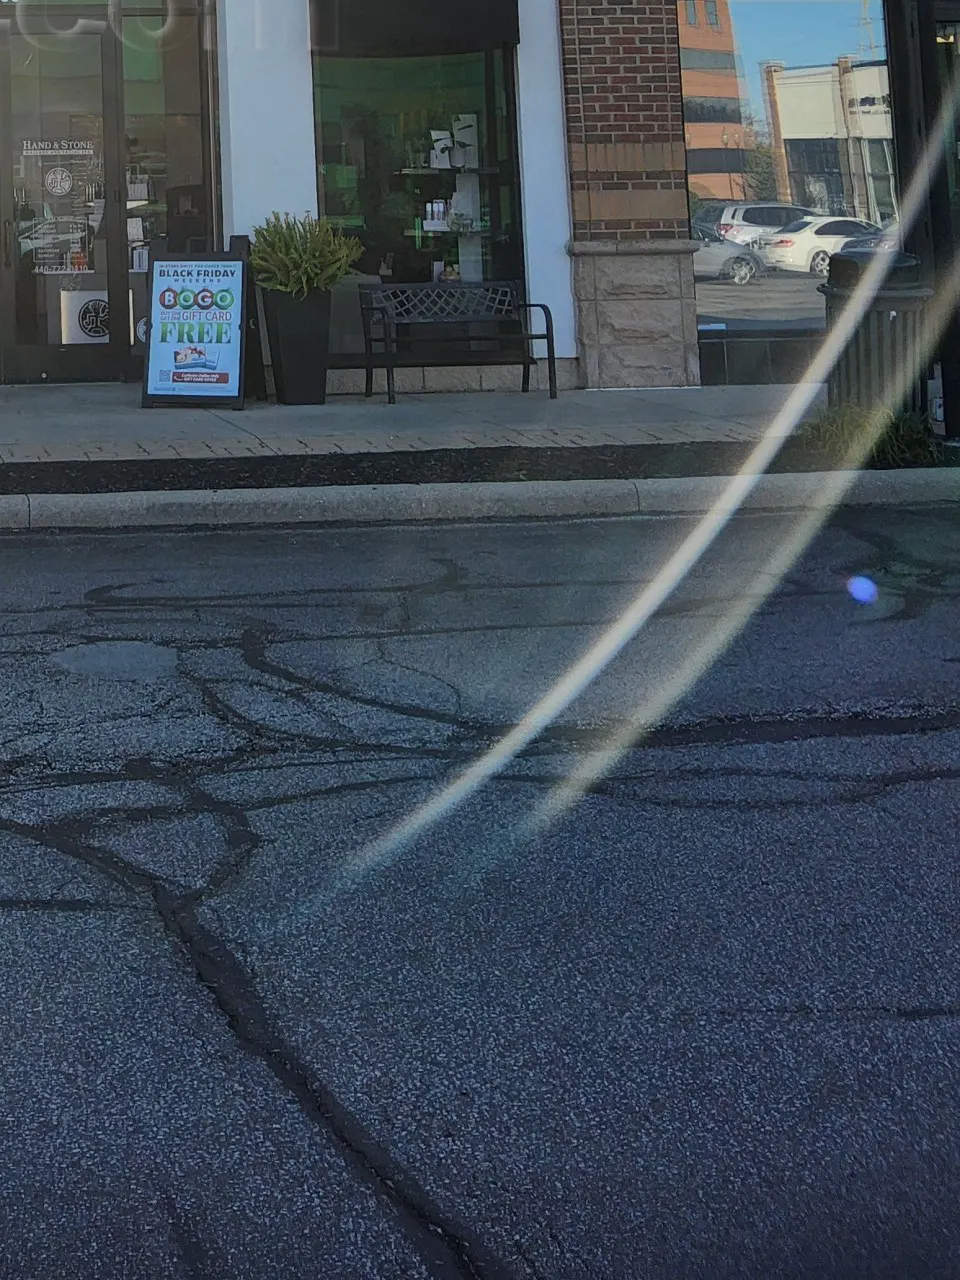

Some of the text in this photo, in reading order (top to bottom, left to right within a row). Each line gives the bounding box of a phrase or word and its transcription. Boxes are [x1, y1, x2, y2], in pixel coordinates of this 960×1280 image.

[23, 140, 94, 149] HAND & STONE
[159, 269, 236, 277] BLACK FRIDAY
[164, 291, 231, 306] BOGO
[182, 311, 232, 321] GIFT CARD
[159, 322, 232, 344] FREE
